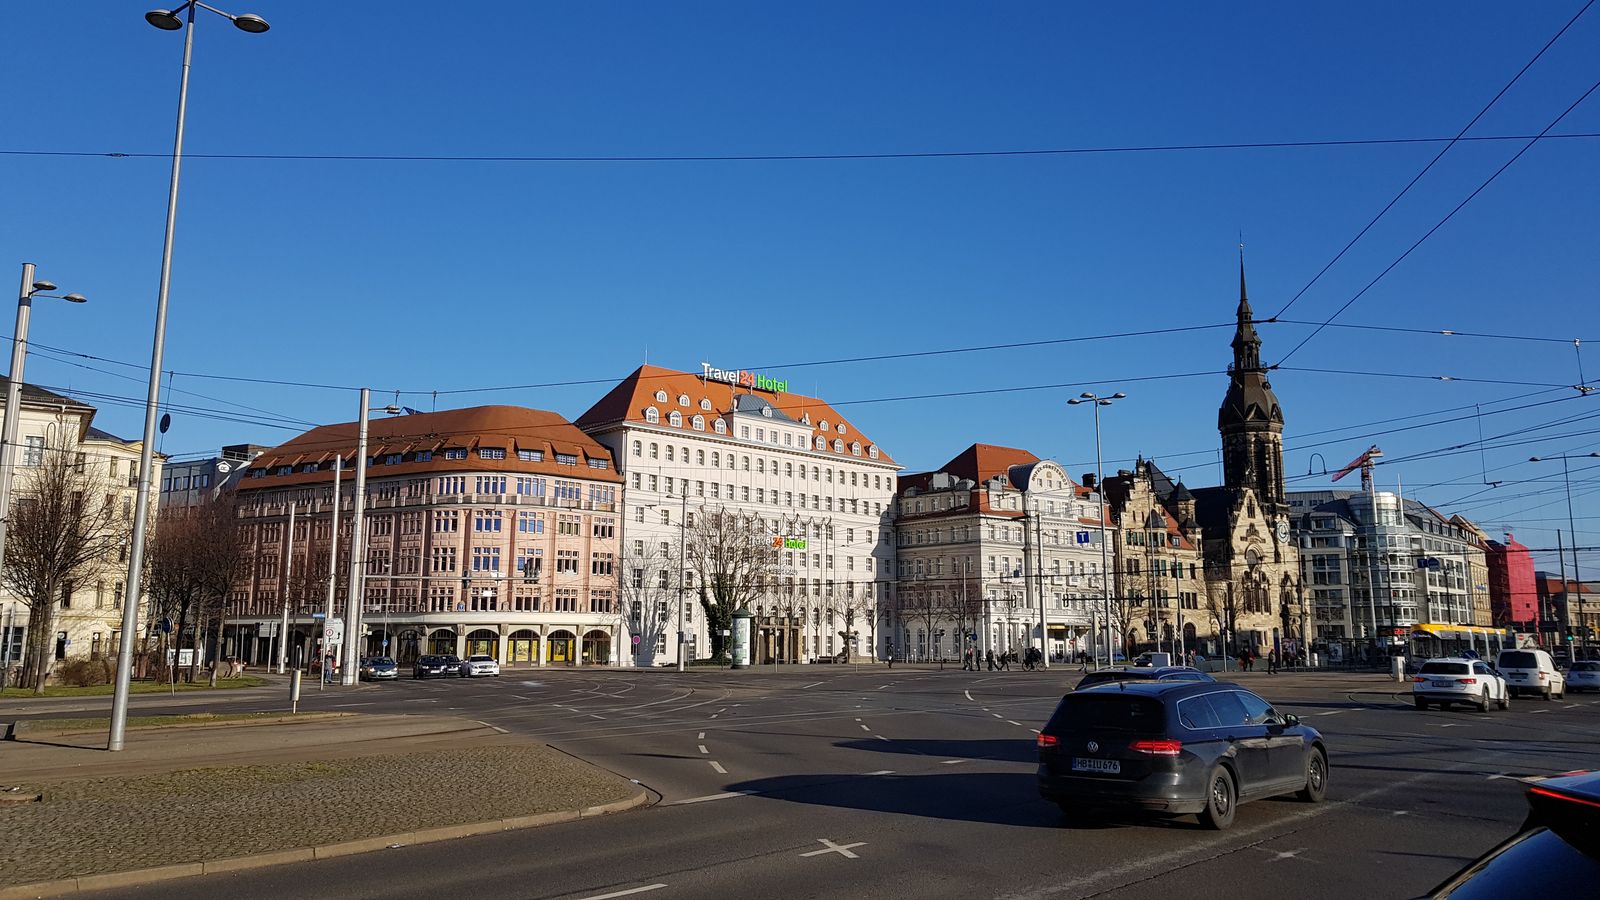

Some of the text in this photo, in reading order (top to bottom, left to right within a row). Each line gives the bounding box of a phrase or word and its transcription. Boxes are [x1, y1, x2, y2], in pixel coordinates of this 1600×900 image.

[701, 362, 788, 393] Travel24 Hotel
[784, 537, 807, 550] Hotel
[1103, 760, 1118, 770] 676
